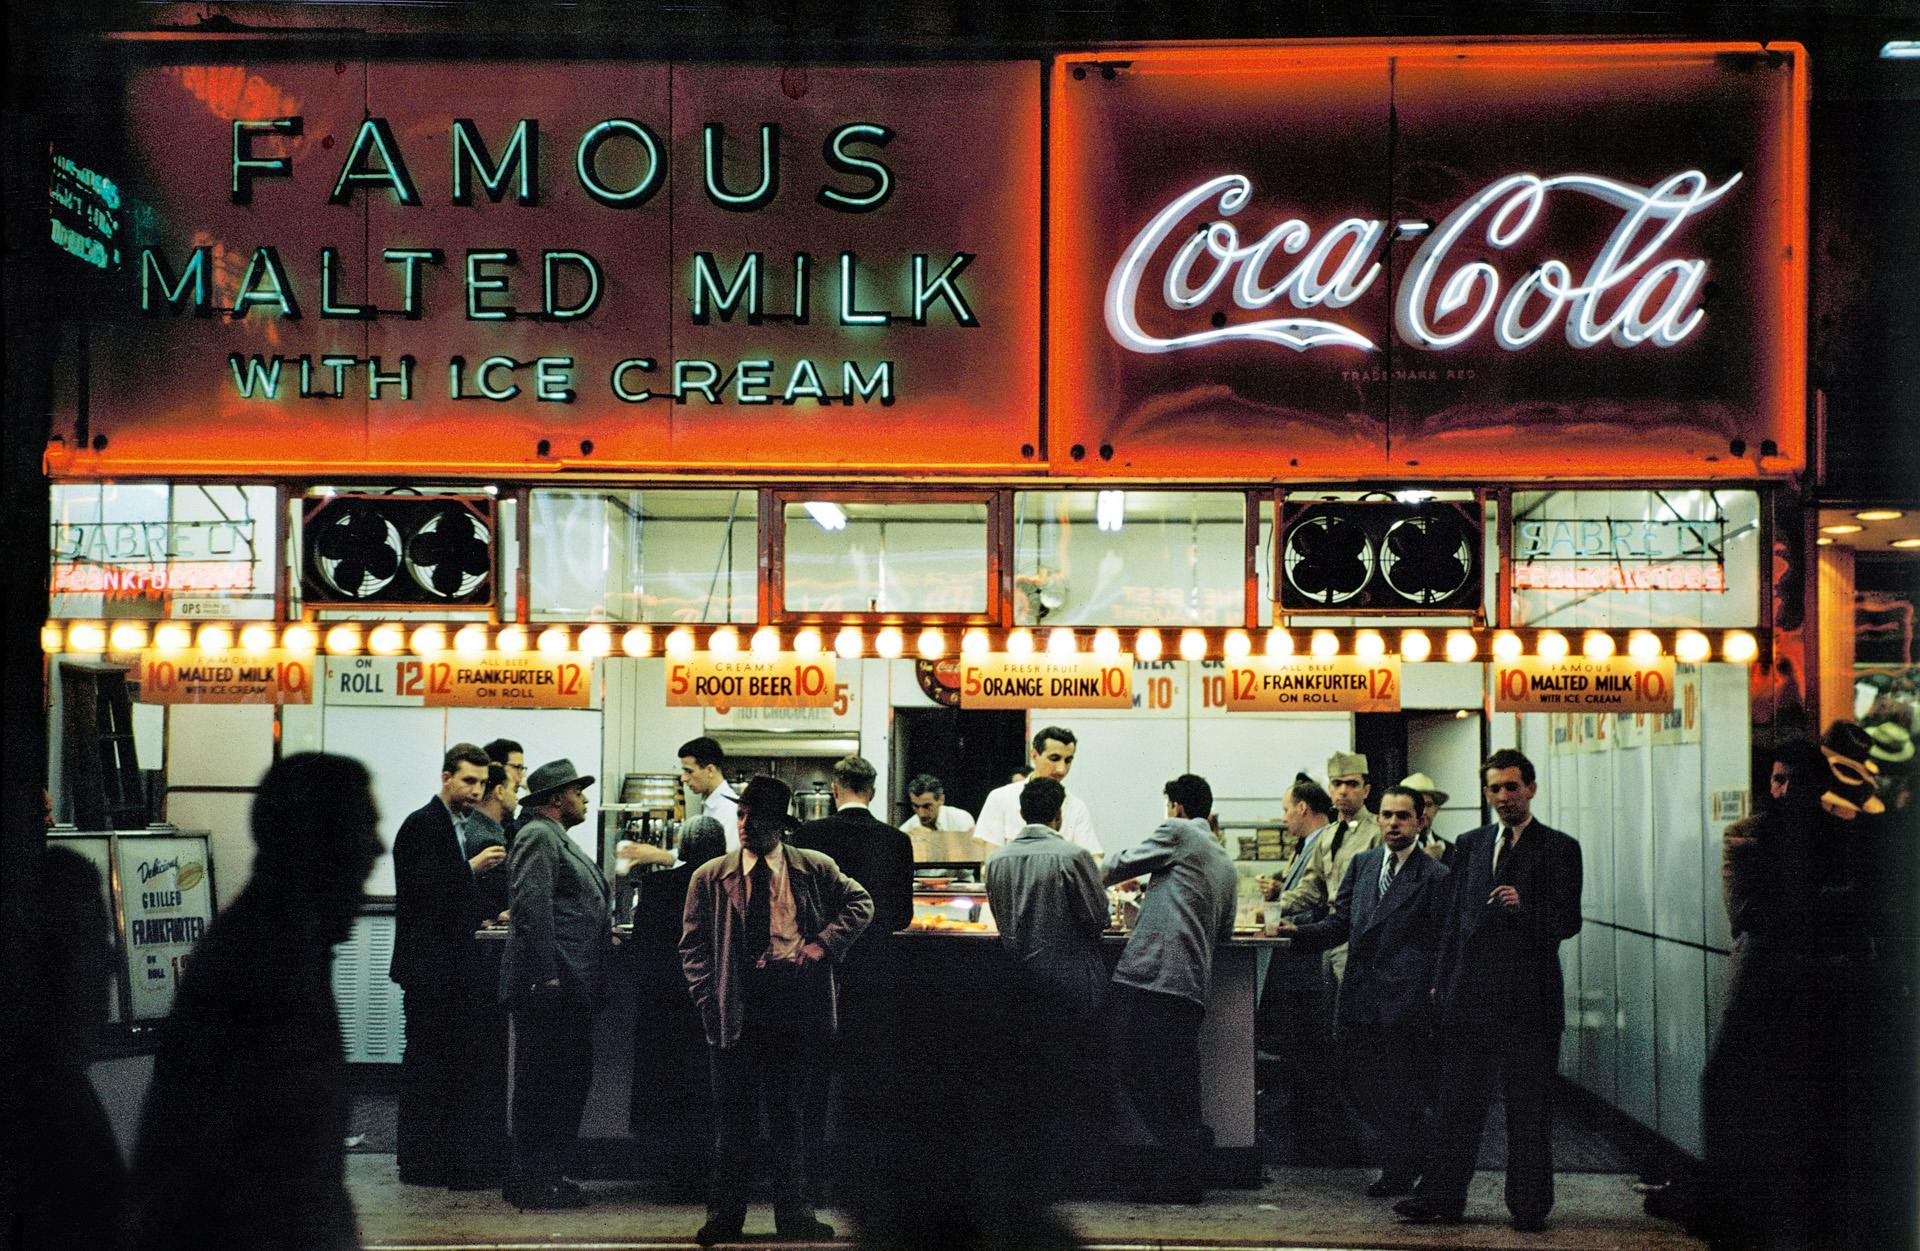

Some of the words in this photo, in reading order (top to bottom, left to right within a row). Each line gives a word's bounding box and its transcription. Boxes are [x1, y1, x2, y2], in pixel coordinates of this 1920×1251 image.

[232, 118, 897, 213] FAMOUS
[1105, 168, 1745, 352] Coca-Cola
[141, 245, 606, 319] MALTED
[692, 251, 980, 328] MILK
[229, 354, 415, 400] WITH
[451, 355, 575, 401] ICE
[611, 357, 895, 406] CREAM
[355, 659, 372, 668] ON
[715, 662, 774, 671] CREAMY
[1003, 664, 1040, 673] FRESH
[1047, 664, 1078, 673] FRUIT
[1308, 664, 1335, 672] BEEF
[1552, 663, 1612, 673] FAMOUS
[178, 666, 234, 682] MALTED
[239, 667, 275, 682] MILK
[341, 673, 383, 693] ROLL
[396, 661, 424, 696] 12
[457, 669, 555, 685] FRANKFURTER
[1263, 674, 1367, 690] FRANKFURTER
[210, 686, 226, 695] ICE
[227, 686, 268, 695] CREAM
[696, 676, 743, 695] ROOT
[749, 676, 792, 696] BEER
[983, 677, 1044, 696] ORANGE
[1051, 678, 1099, 697] DRINK
[1531, 675, 1588, 691] MALTED
[1595, 675, 1632, 691] MILK
[476, 688, 496, 698] ON
[502, 688, 535, 698] ROLL
[1202, 675, 1226, 708] 10
[1279, 693, 1298, 703] ON
[1303, 693, 1339, 703] ROLL
[1540, 694, 1561, 703] WITH
[1564, 694, 1581, 704] ICE
[1584, 694, 1622, 704] CREAM
[142, 890, 182, 909] GRILLED
